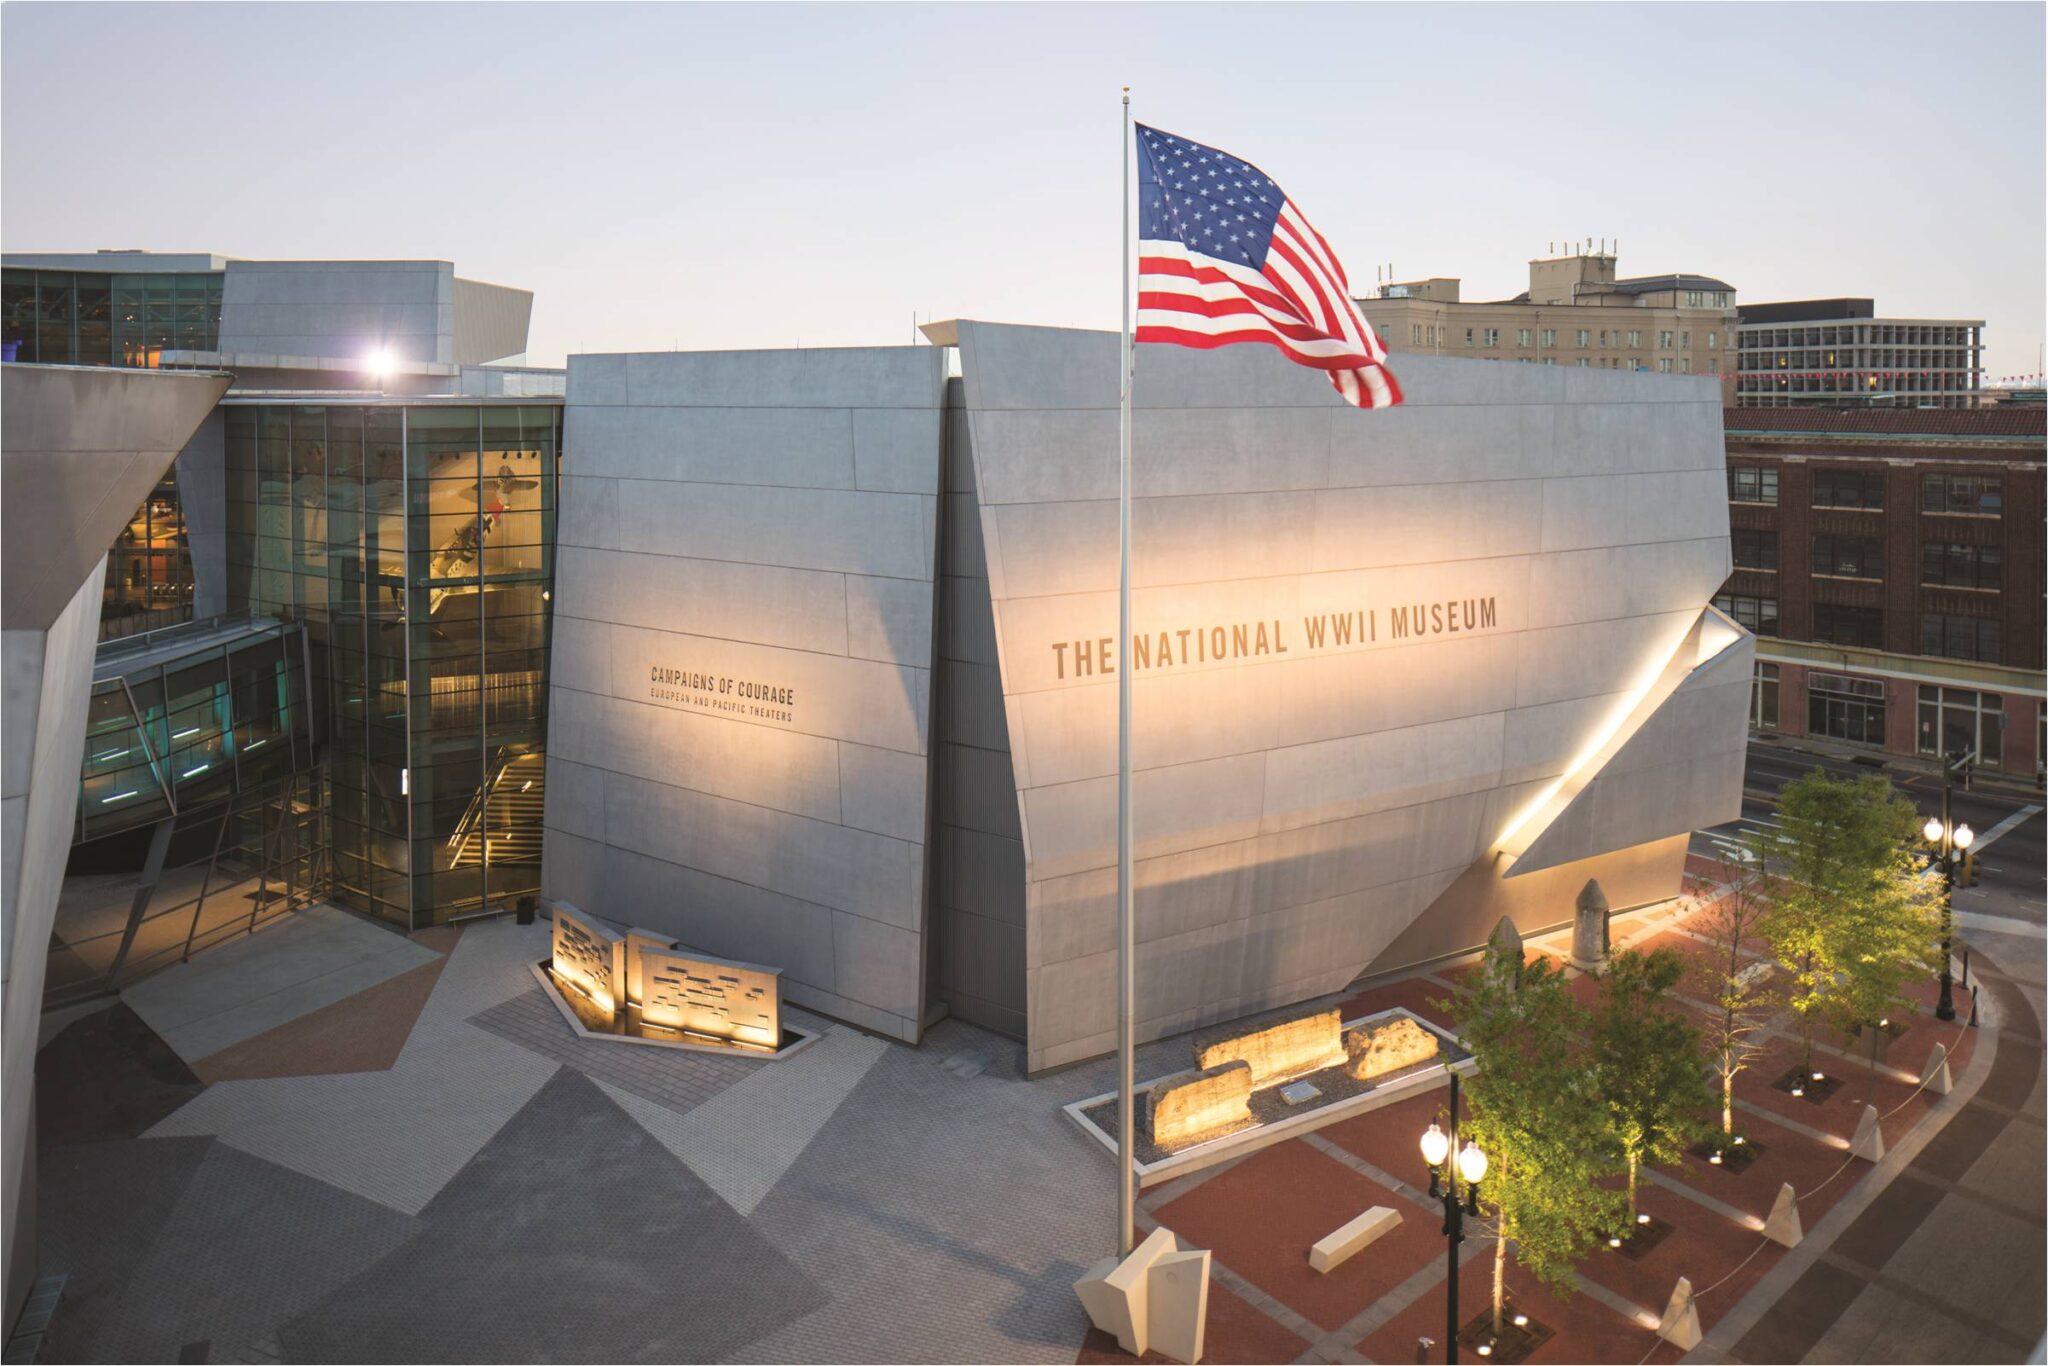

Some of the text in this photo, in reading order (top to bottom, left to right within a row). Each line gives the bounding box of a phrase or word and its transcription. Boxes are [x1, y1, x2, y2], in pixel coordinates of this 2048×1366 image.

[1052, 597, 1496, 679] THE NATIONAL WWII MUSEUM
[651, 666, 794, 705] CAMPAIGNS OF COURAGE
[651, 687, 792, 722] EUROPEAN AND PACIFIC THEATERS
